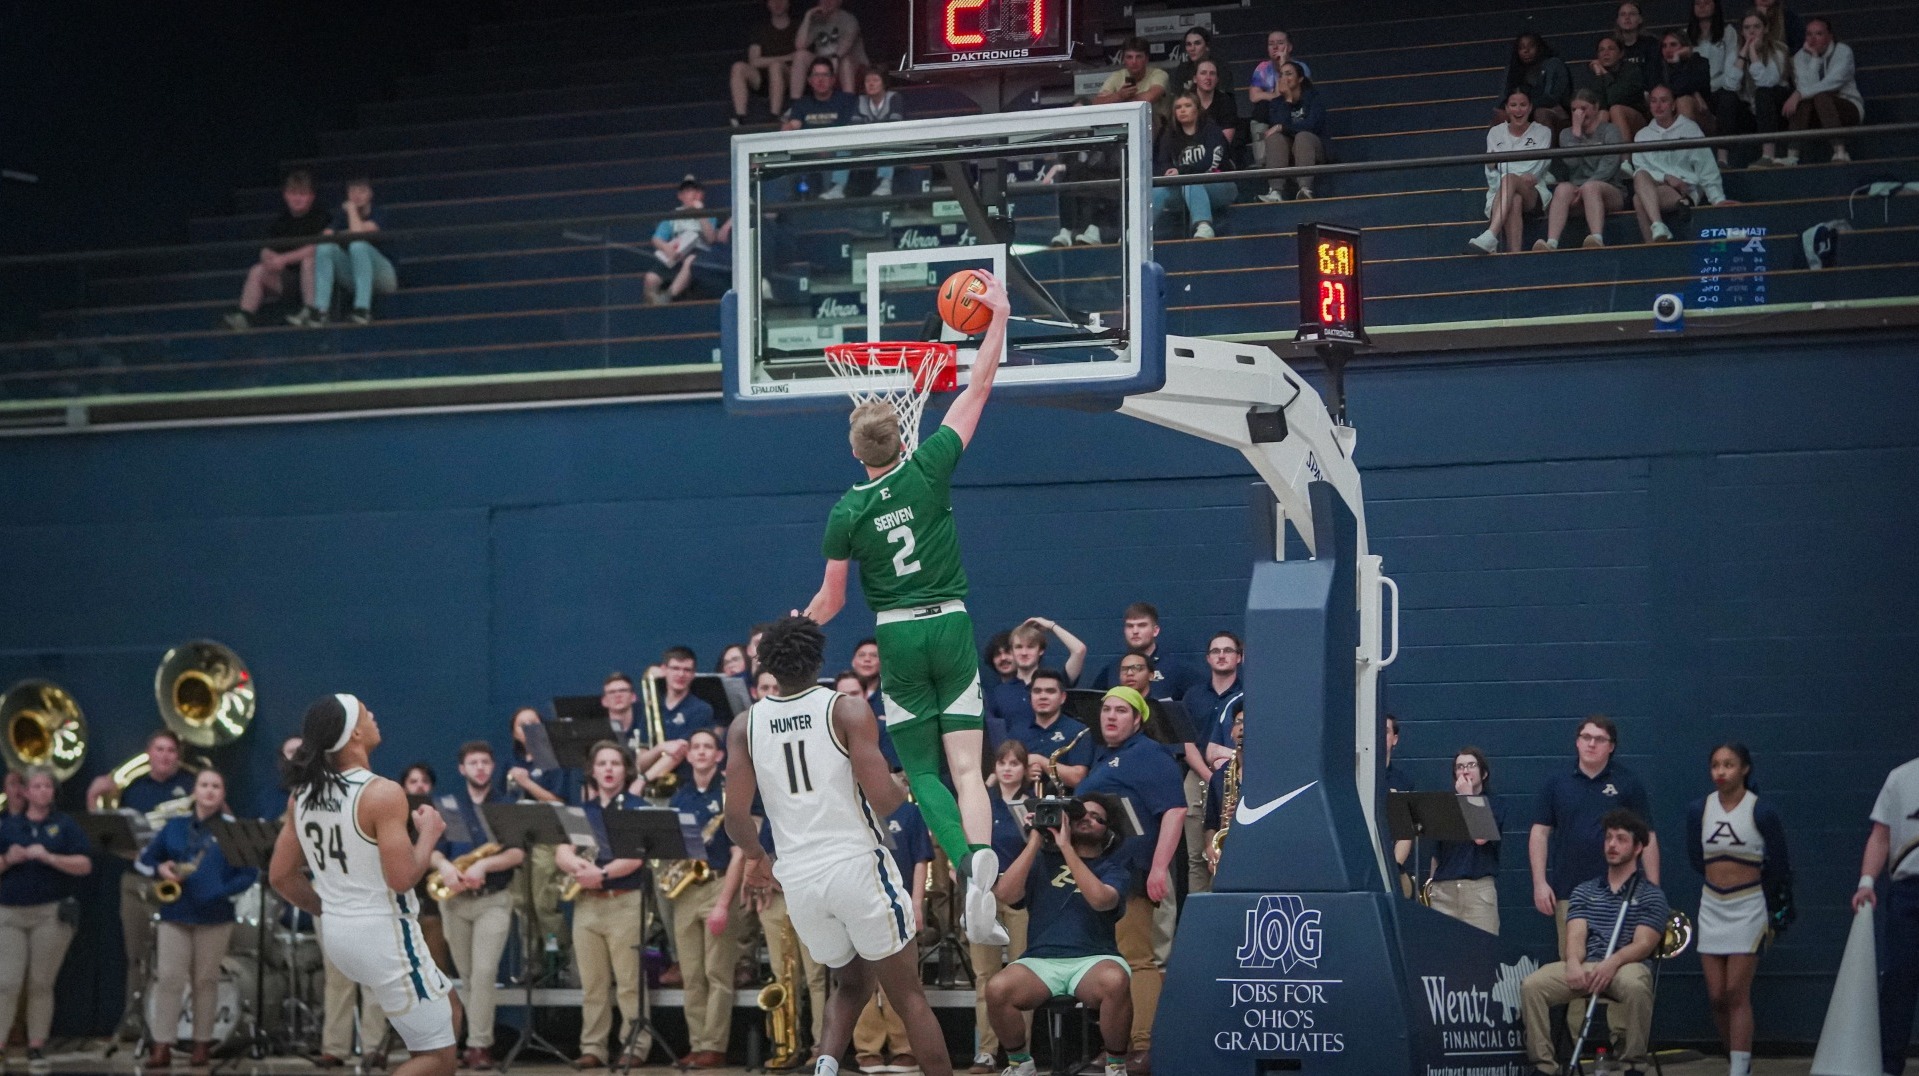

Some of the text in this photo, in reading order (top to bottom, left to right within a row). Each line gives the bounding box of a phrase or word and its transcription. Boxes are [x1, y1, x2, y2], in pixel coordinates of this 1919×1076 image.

[951, 49, 1029, 62] DAKTRONICS
[899, 229, 940, 249] Akron
[816, 297, 860, 318] Akron
[1324, 328, 1354, 338] DAKTRONICS
[751, 384, 789, 395] SPALDING
[880, 487, 892, 500] E
[873, 506, 914, 532] SERVEN
[887, 525, 921, 577] 2
[770, 714, 812, 734] HUNTER
[783, 740, 813, 794] 11
[1706, 821, 1746, 846] A
[305, 821, 349, 874] 34
[1236, 909, 1322, 961] JOG
[1230, 983, 1328, 1008] JOBS FOR
[1421, 976, 1495, 1028] Wentz
[1243, 1008, 1315, 1029] OHIO'S
[1214, 1031, 1345, 1052] GRADUATES
[1442, 1030, 1503, 1050] FINANCIAL
